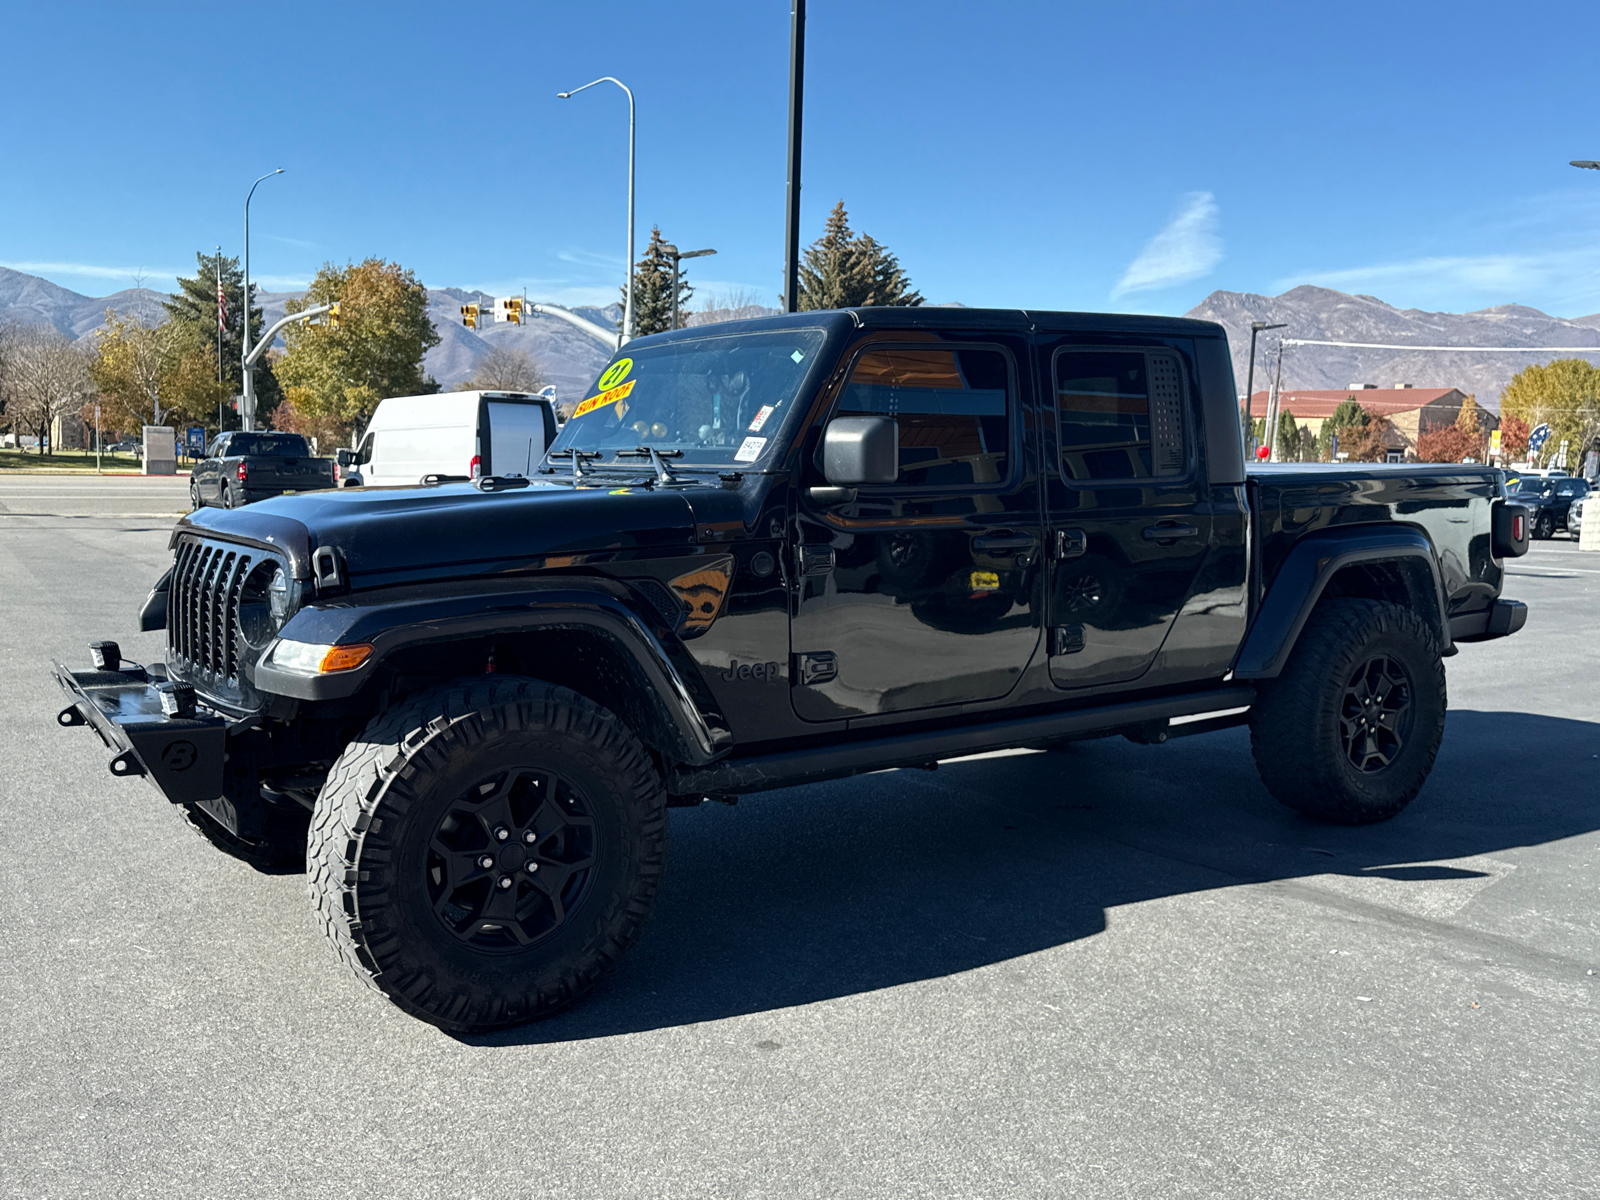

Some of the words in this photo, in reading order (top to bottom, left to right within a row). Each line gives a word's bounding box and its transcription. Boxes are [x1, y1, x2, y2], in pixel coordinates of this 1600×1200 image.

[602, 361, 630, 387] 21
[575, 395, 602, 416] SUN
[600, 381, 634, 405] ROOF
[721, 659, 780, 682] Jeep
